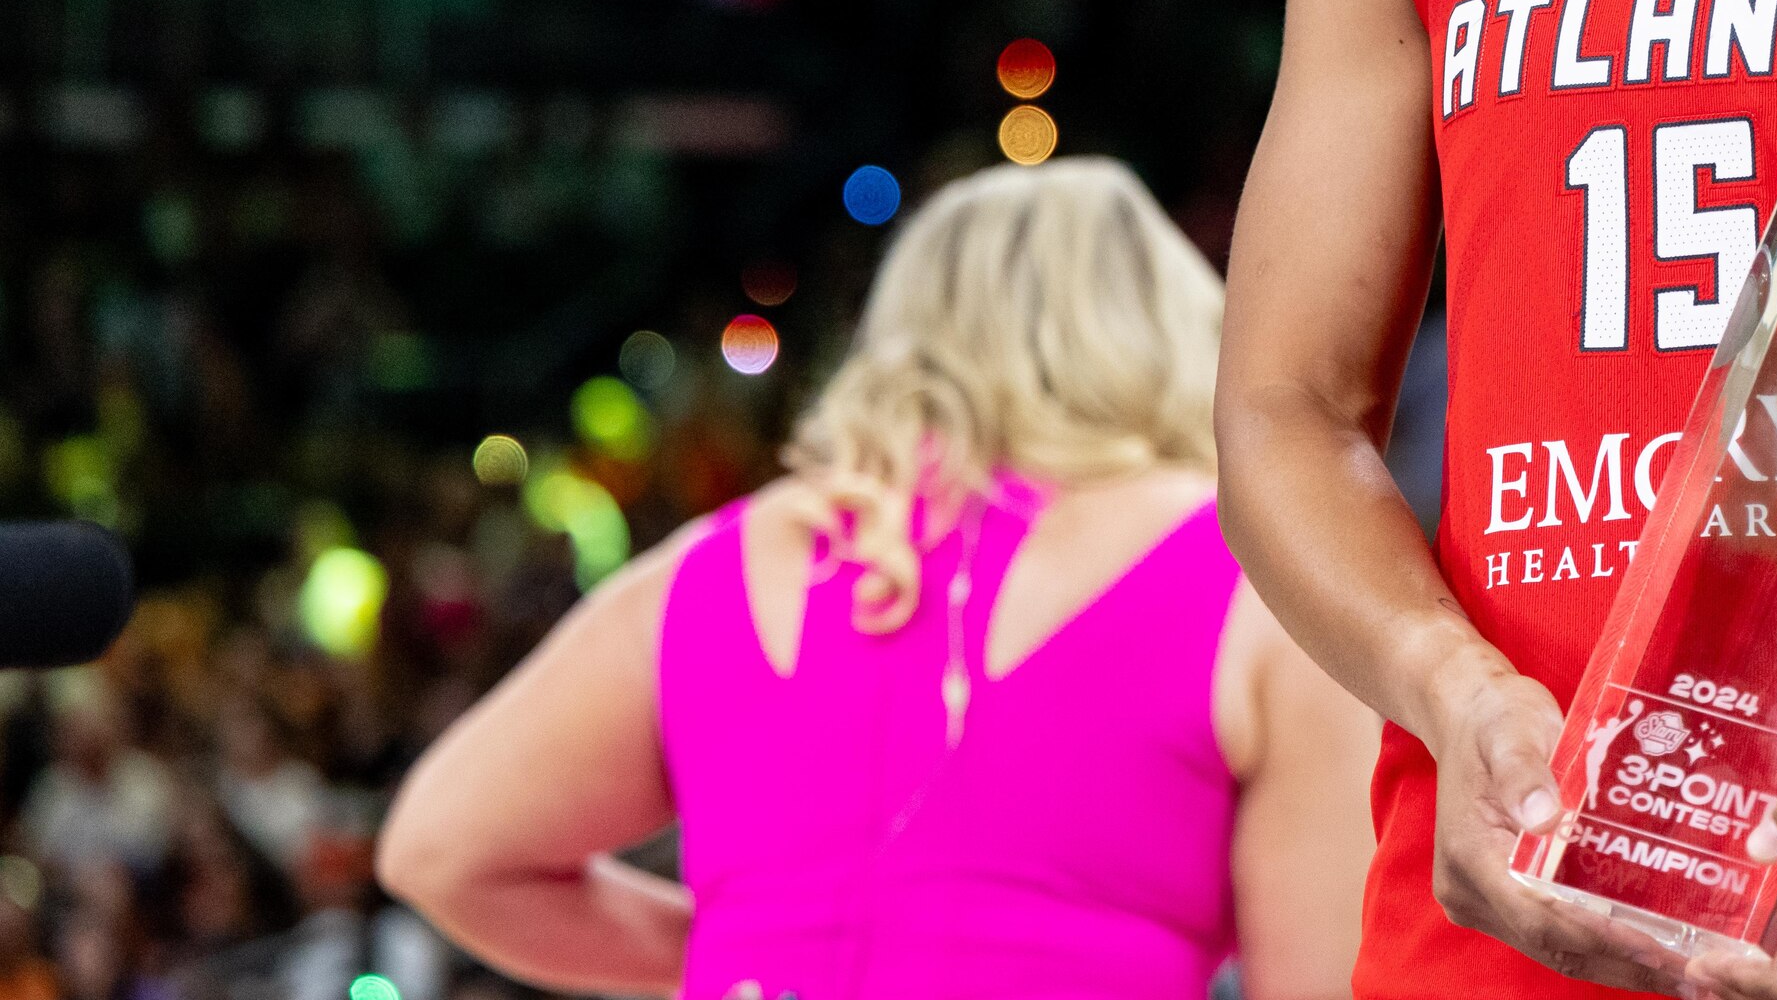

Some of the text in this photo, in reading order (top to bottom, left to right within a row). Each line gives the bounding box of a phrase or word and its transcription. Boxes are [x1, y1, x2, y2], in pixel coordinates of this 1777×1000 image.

[1565, 117, 1757, 352] 15
[1669, 673, 1760, 717] 2024
[1607, 786, 1750, 840] CONTEST
[1559, 821, 1750, 894] CHAMPION
